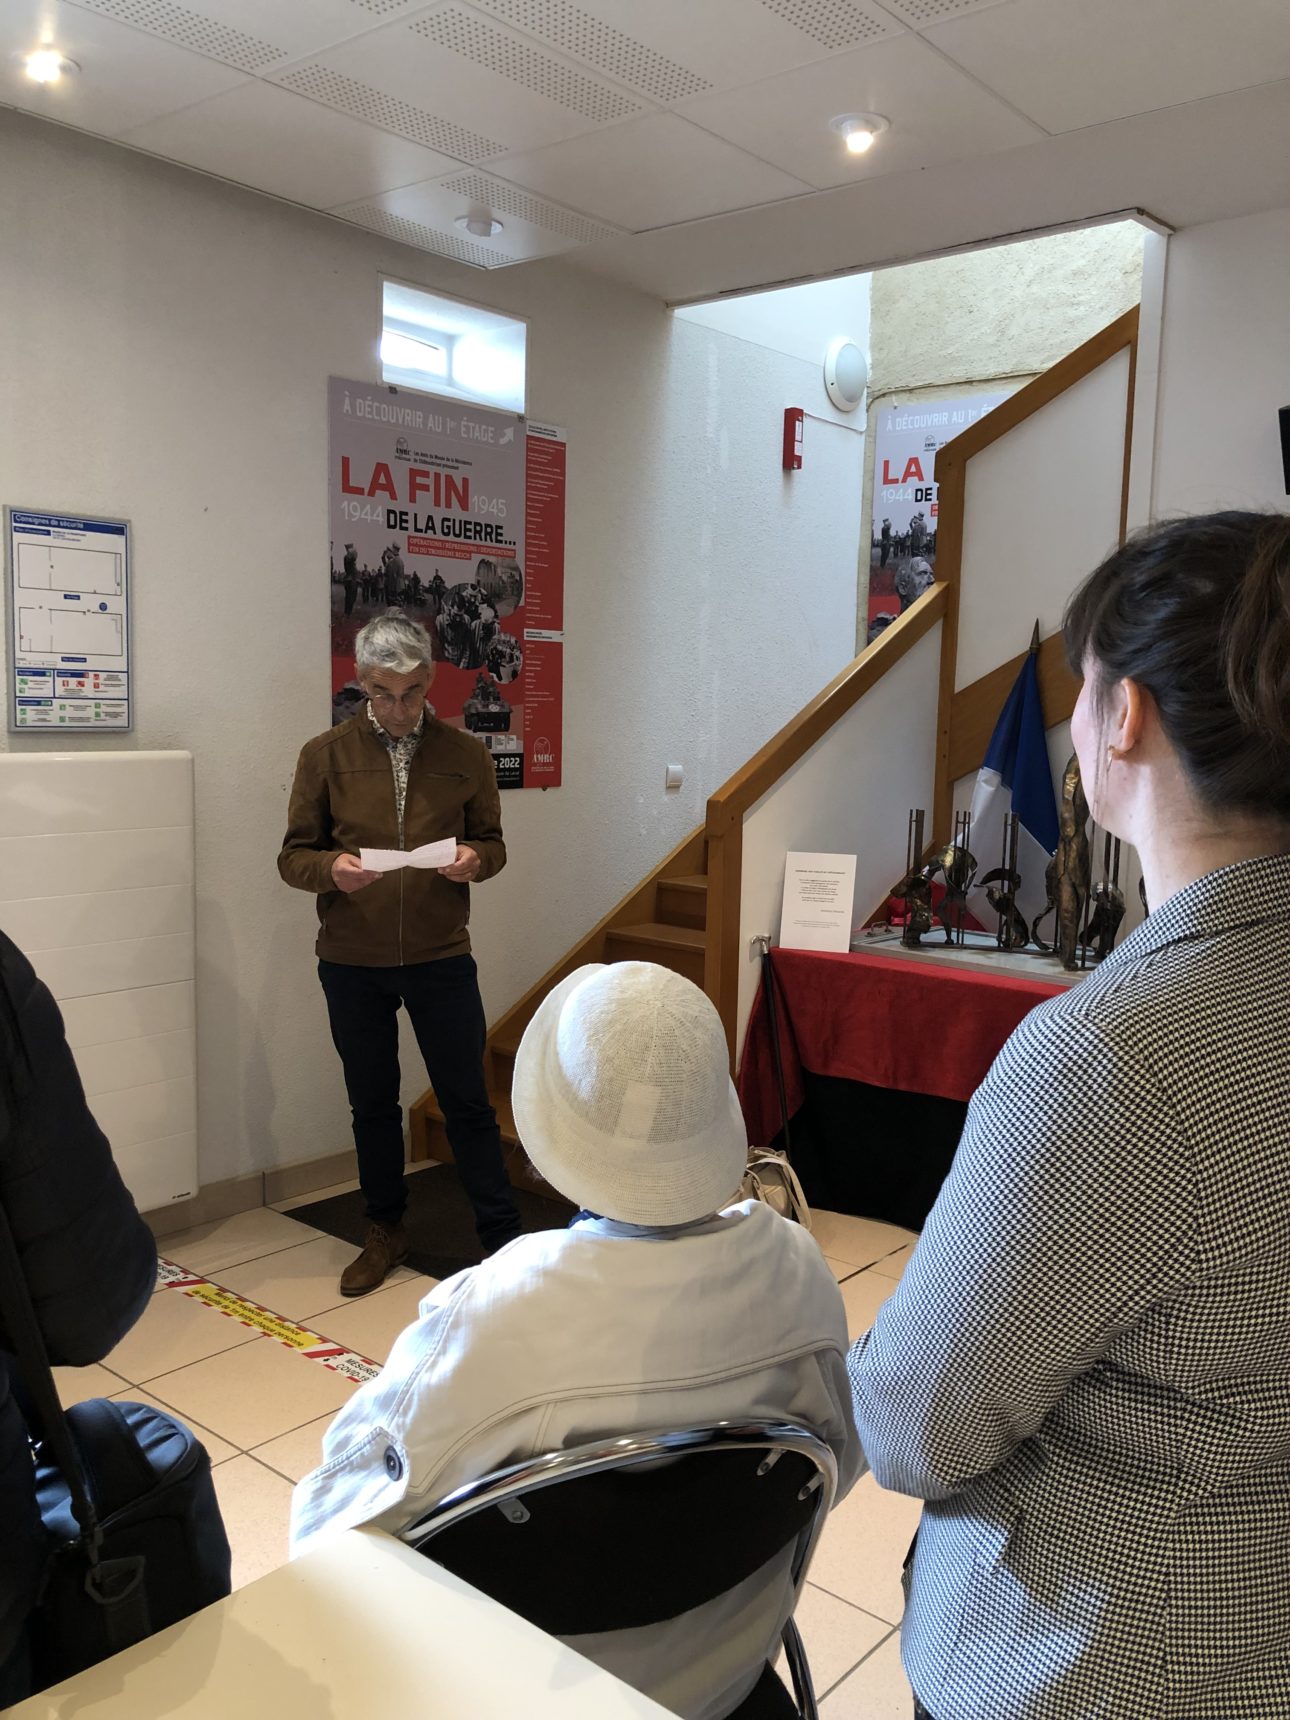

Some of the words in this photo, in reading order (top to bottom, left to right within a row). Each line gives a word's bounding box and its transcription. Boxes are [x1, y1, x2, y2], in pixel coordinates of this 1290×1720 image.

[343, 391, 352, 414] À
[356, 396, 424, 429] DÉCOUVRIR
[427, 414, 443, 433] AU
[461, 417, 496, 444] ÉTAGE
[886, 415, 893, 431] À
[895, 411, 949, 431] DÉCOUVRIR
[952, 410, 965, 424] AU
[882, 456, 925, 486] LA
[341, 455, 398, 502] LA
[408, 467, 470, 513] FIN
[880, 487, 913, 504] 1944
[914, 487, 933, 503] DE
[340, 500, 384, 526] 1944
[472, 494, 507, 518] 1945
[15, 514, 50, 526] Consignes
[50, 518, 59, 526] de
[386, 508, 409, 532] DE
[413, 512, 437, 536] LA
[440, 517, 517, 546] GUERRE...
[499, 757, 520, 769] 2022
[214, 1291, 233, 1301] Merci
[238, 1302, 266, 1318] respecter
[262, 1316, 276, 1324] une
[274, 1322, 302, 1336] distance
[238, 1313, 255, 1322] entre
[253, 1320, 277, 1333] chaque
[273, 1331, 305, 1347] personne
[335, 1363, 370, 1382] COVID-19
[345, 1358, 380, 1378] MESURES
